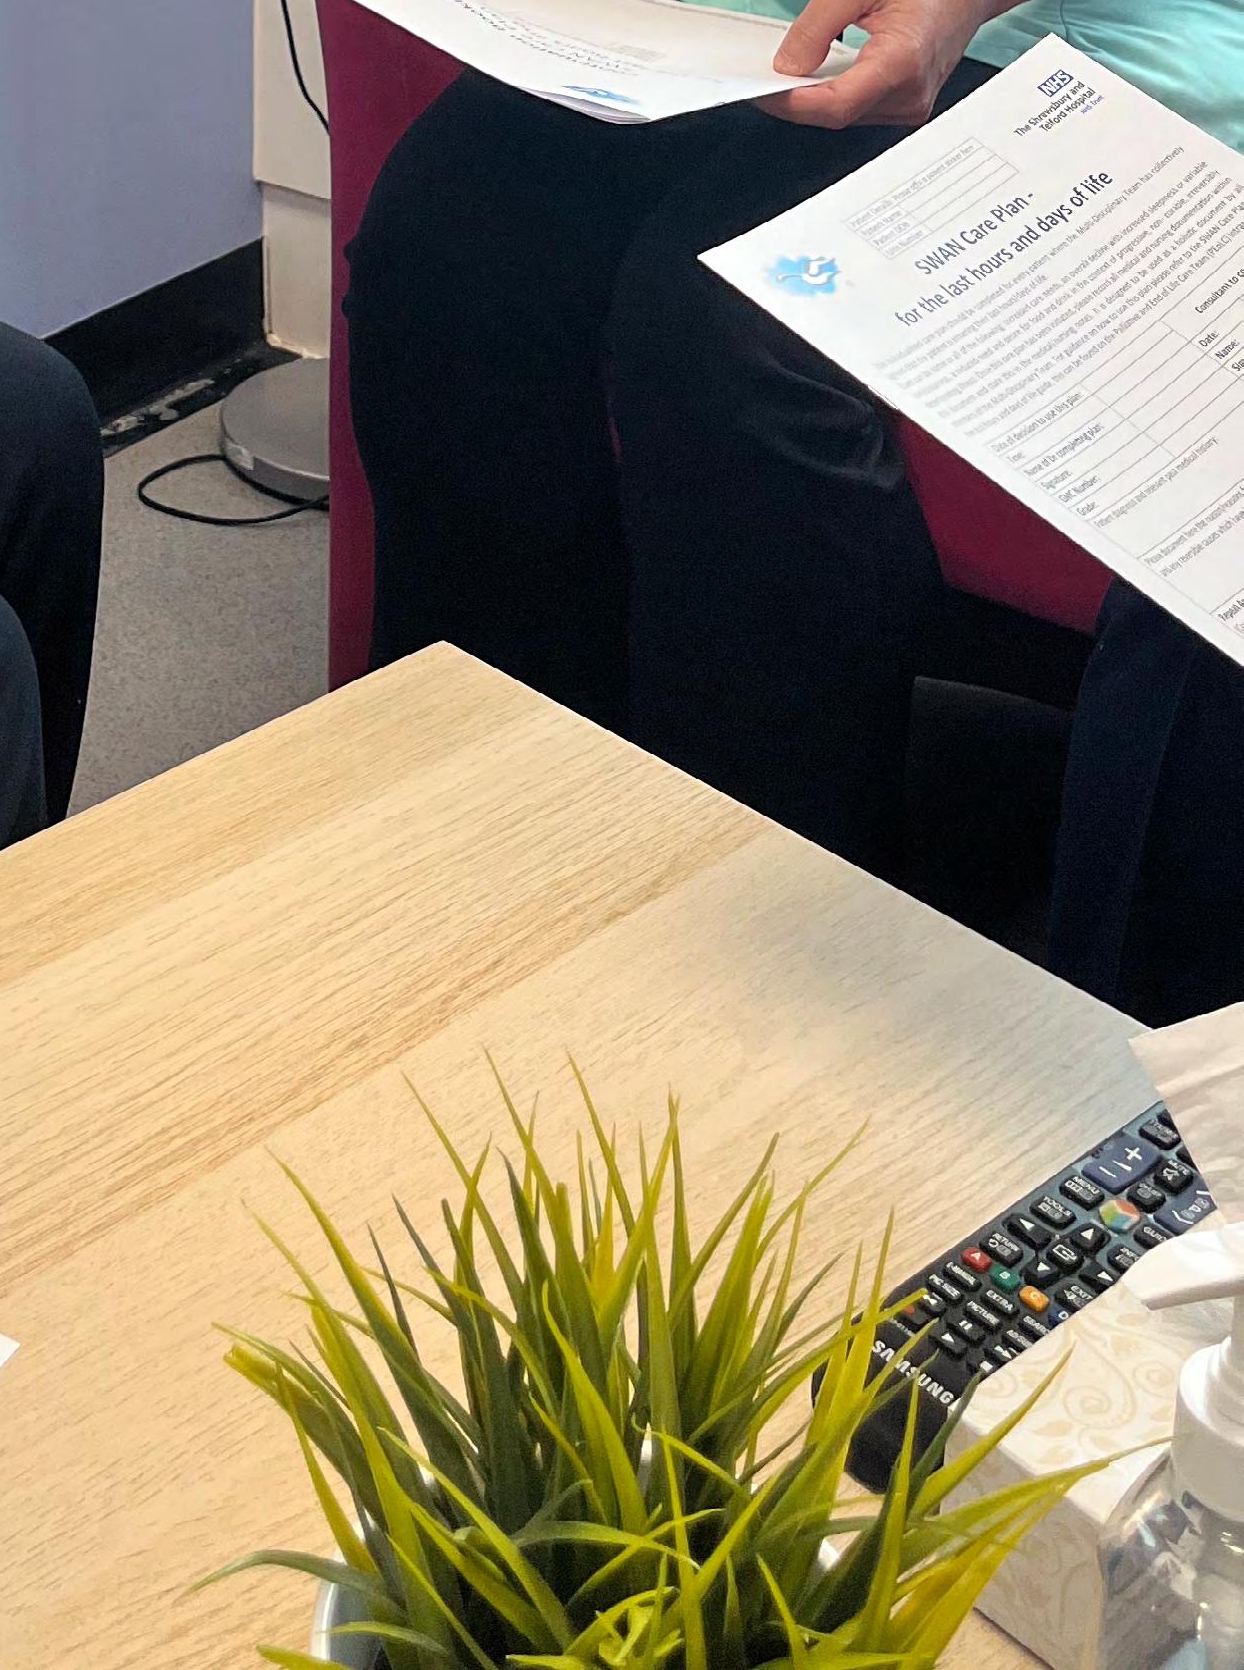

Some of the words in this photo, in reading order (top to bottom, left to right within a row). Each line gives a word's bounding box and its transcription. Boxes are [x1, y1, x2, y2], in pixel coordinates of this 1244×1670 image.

[1039, 70, 1071, 96] NHS
[1014, 125, 1031, 136] The
[1029, 93, 1071, 126] Shrewsbury
[1071, 80, 1084, 94] and
[1065, 87, 1095, 113] Hospital
[914, 238, 966, 274] SWAN
[959, 219, 997, 244] Care
[989, 197, 1029, 222] Plan
[1198, 224, 1220, 244] SWAN
[894, 308, 923, 326] for
[917, 293, 949, 312] the
[939, 274, 975, 297] last
[964, 248, 1014, 281] hours
[1010, 224, 1041, 252] and
[1035, 204, 1073, 232] days
[1069, 186, 1089, 206] of
[1079, 172, 1113, 194] life
[1148, 293, 1164, 306] End
[1165, 280, 1180, 291] Life
[1176, 269, 1194, 282] Care
[1189, 255, 1210, 270] Team
[1194, 282, 1232, 313] Consultant
[1227, 276, 1239, 284] to
[1198, 331, 1221, 346] Date:
[1214, 338, 1239, 359] Name:
[1166, 1157, 1192, 1177] MUTE
[1070, 1173, 1101, 1197] MENU
[1041, 1194, 1073, 1218] TOOLS
[1187, 1203, 1202, 1216] P
[991, 1230, 1021, 1254] RETURN
[969, 1249, 983, 1261] A
[927, 1272, 945, 1287] PIC
[939, 1281, 962, 1299] SIZE
[1068, 1283, 1093, 1302] EXIT
[984, 1288, 1015, 1312] EXTRA
[965, 1299, 1001, 1326] PICTURE
